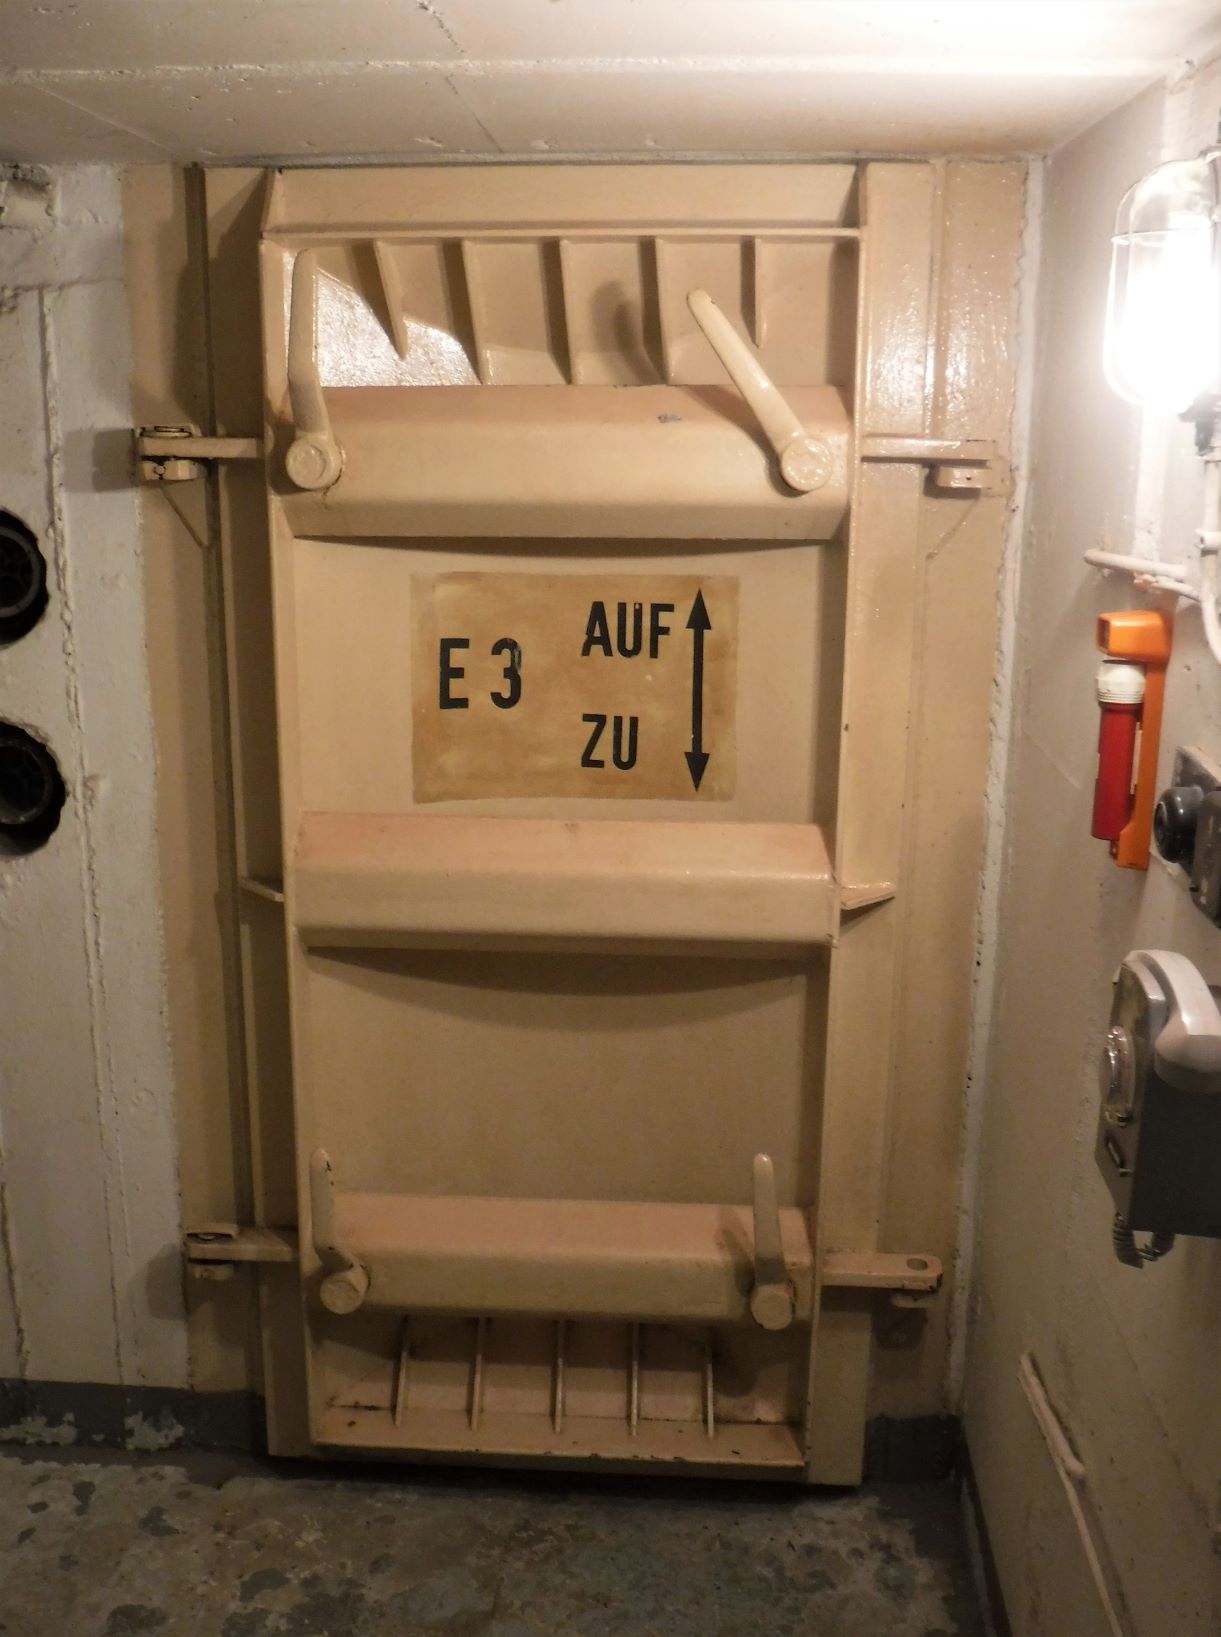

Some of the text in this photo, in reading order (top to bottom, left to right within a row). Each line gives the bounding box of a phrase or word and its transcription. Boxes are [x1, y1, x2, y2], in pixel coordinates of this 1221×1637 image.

[581, 600, 675, 659] AUF
[439, 637, 522, 710] E 3
[581, 713, 639, 771] ZU
